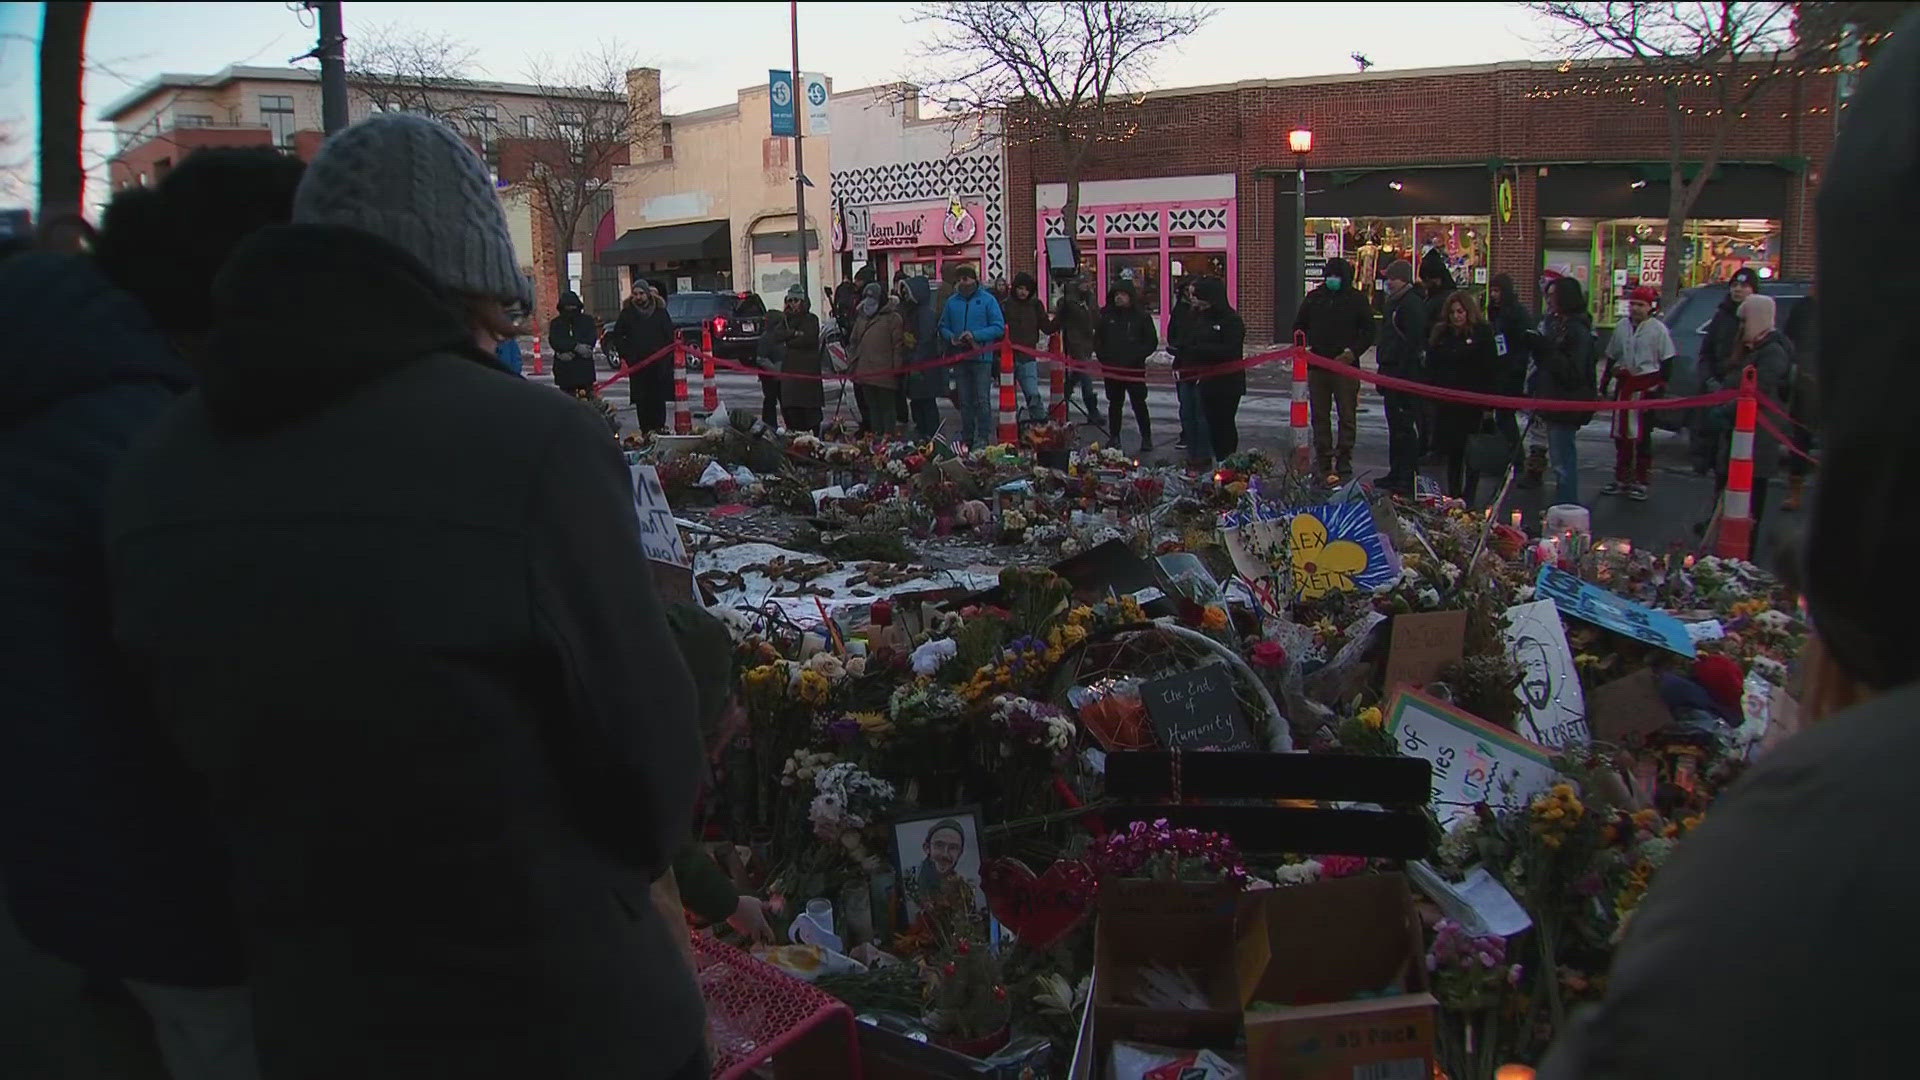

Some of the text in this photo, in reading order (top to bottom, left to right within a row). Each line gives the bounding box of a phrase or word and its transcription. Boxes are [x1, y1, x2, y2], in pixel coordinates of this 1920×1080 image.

[868, 219, 923, 238] lam Doll
[1161, 677, 1214, 704] The End
[1185, 697, 1195, 714] of
[1168, 714, 1235, 746] Humanity
[1403, 724, 1428, 751] of
